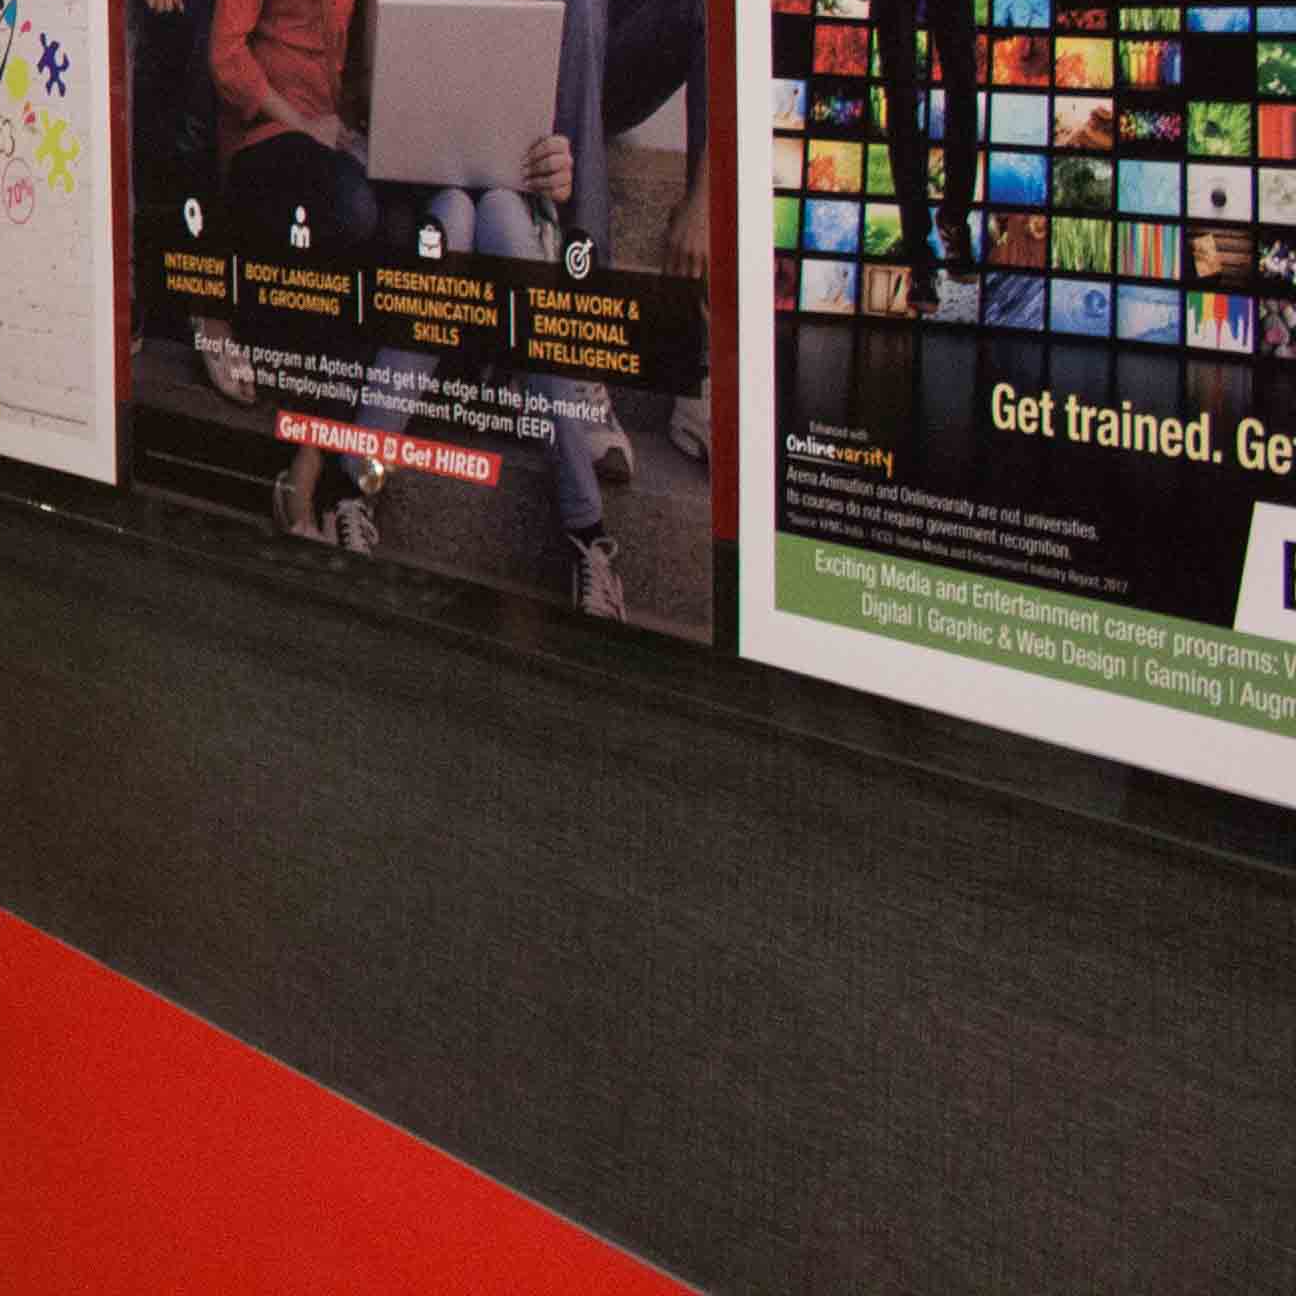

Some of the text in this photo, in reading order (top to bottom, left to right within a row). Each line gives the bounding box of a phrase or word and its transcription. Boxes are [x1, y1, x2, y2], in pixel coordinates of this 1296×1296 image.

[164, 253, 225, 276] INTERVIEW
[245, 262, 351, 294] BODY LANGUAGE
[166, 274, 226, 298] HANDLING
[270, 289, 340, 316] GROOMING
[376, 268, 496, 302] PRESENTATION &
[373, 292, 499, 327] COMMUNICATION
[528, 287, 640, 321] TEAM WORK &
[412, 321, 461, 347] SKILLS
[533, 314, 629, 346] EMOTIONAL
[528, 338, 640, 374] INTELLIGENCE
[194, 332, 608, 424] Enrol for a program at Aptech and get the edge in the job-market
[257, 368, 276, 388] the
[278, 370, 358, 407] Employability
[360, 386, 450, 422] Enhancement
[454, 403, 513, 432] Program
[516, 415, 556, 446] (EEP)
[992, 382, 1296, 475] Get trained. Ge
[279, 415, 490, 481] Get TRAINED Get HIRED
[786, 434, 894, 480] Onlinevarsity
[801, 494, 844, 514] courses
[846, 499, 861, 516] do
[863, 504, 881, 522] not
[883, 509, 924, 532] require
[926, 518, 997, 545] government
[999, 532, 1073, 561] recognition.
[876, 482, 898, 501] and
[977, 504, 997, 521] are
[1000, 507, 1021, 527] not
[1024, 512, 1100, 542] universities.
[815, 549, 876, 589] Exciting
[881, 563, 931, 596] Media
[936, 578, 968, 605] and
[972, 583, 1101, 636] Entertainment
[1104, 616, 1168, 649] career
[1174, 632, 1279, 676] programs:
[861, 594, 912, 629] Digital
[927, 612, 992, 649] Graphic
[998, 623, 1011, 651] &
[1016, 627, 1055, 662] Web
[1062, 638, 1126, 680] Design
[1144, 658, 1221, 706] Gaming
